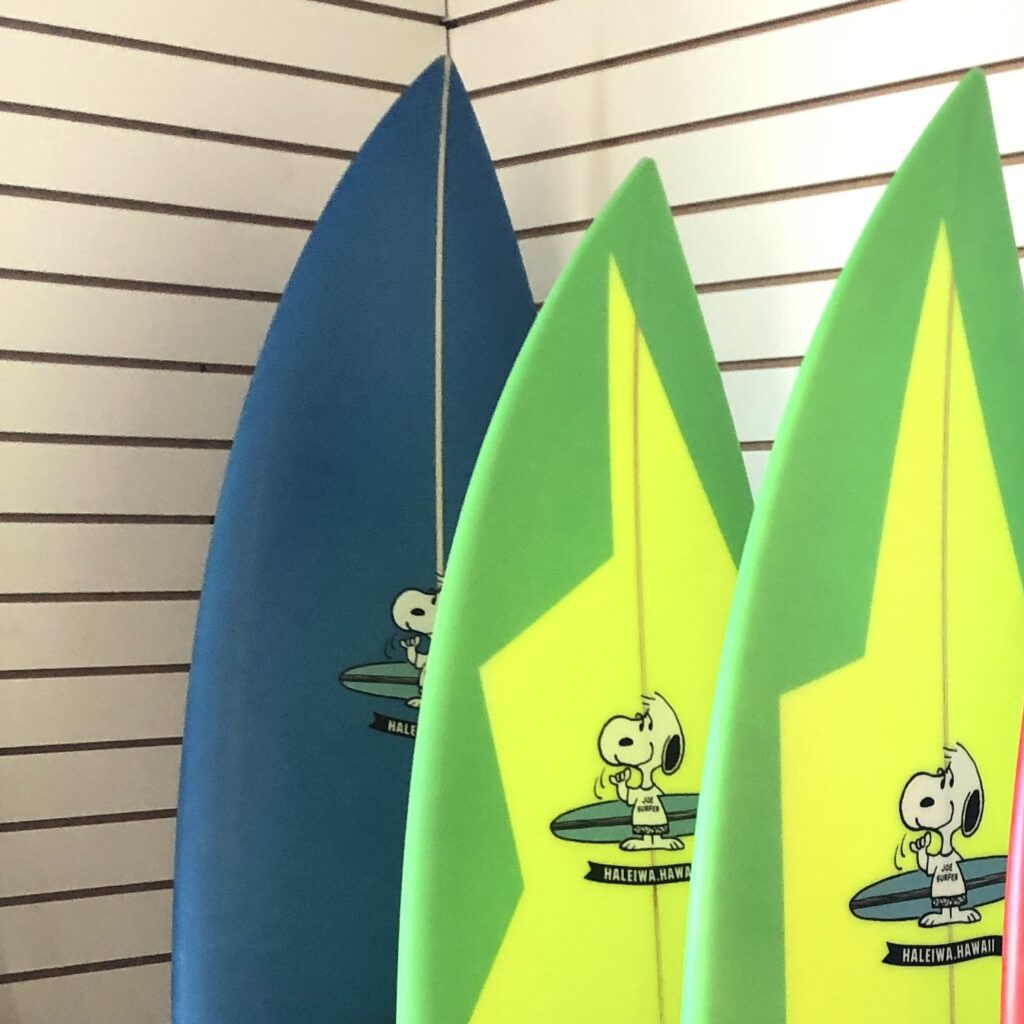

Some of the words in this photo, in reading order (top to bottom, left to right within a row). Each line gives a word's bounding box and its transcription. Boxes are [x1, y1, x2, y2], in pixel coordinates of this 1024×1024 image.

[941, 863, 953, 872] JOE
[936, 873, 959, 883] SURFER
[902, 938, 995, 963] HALEIWA.HAWAII
